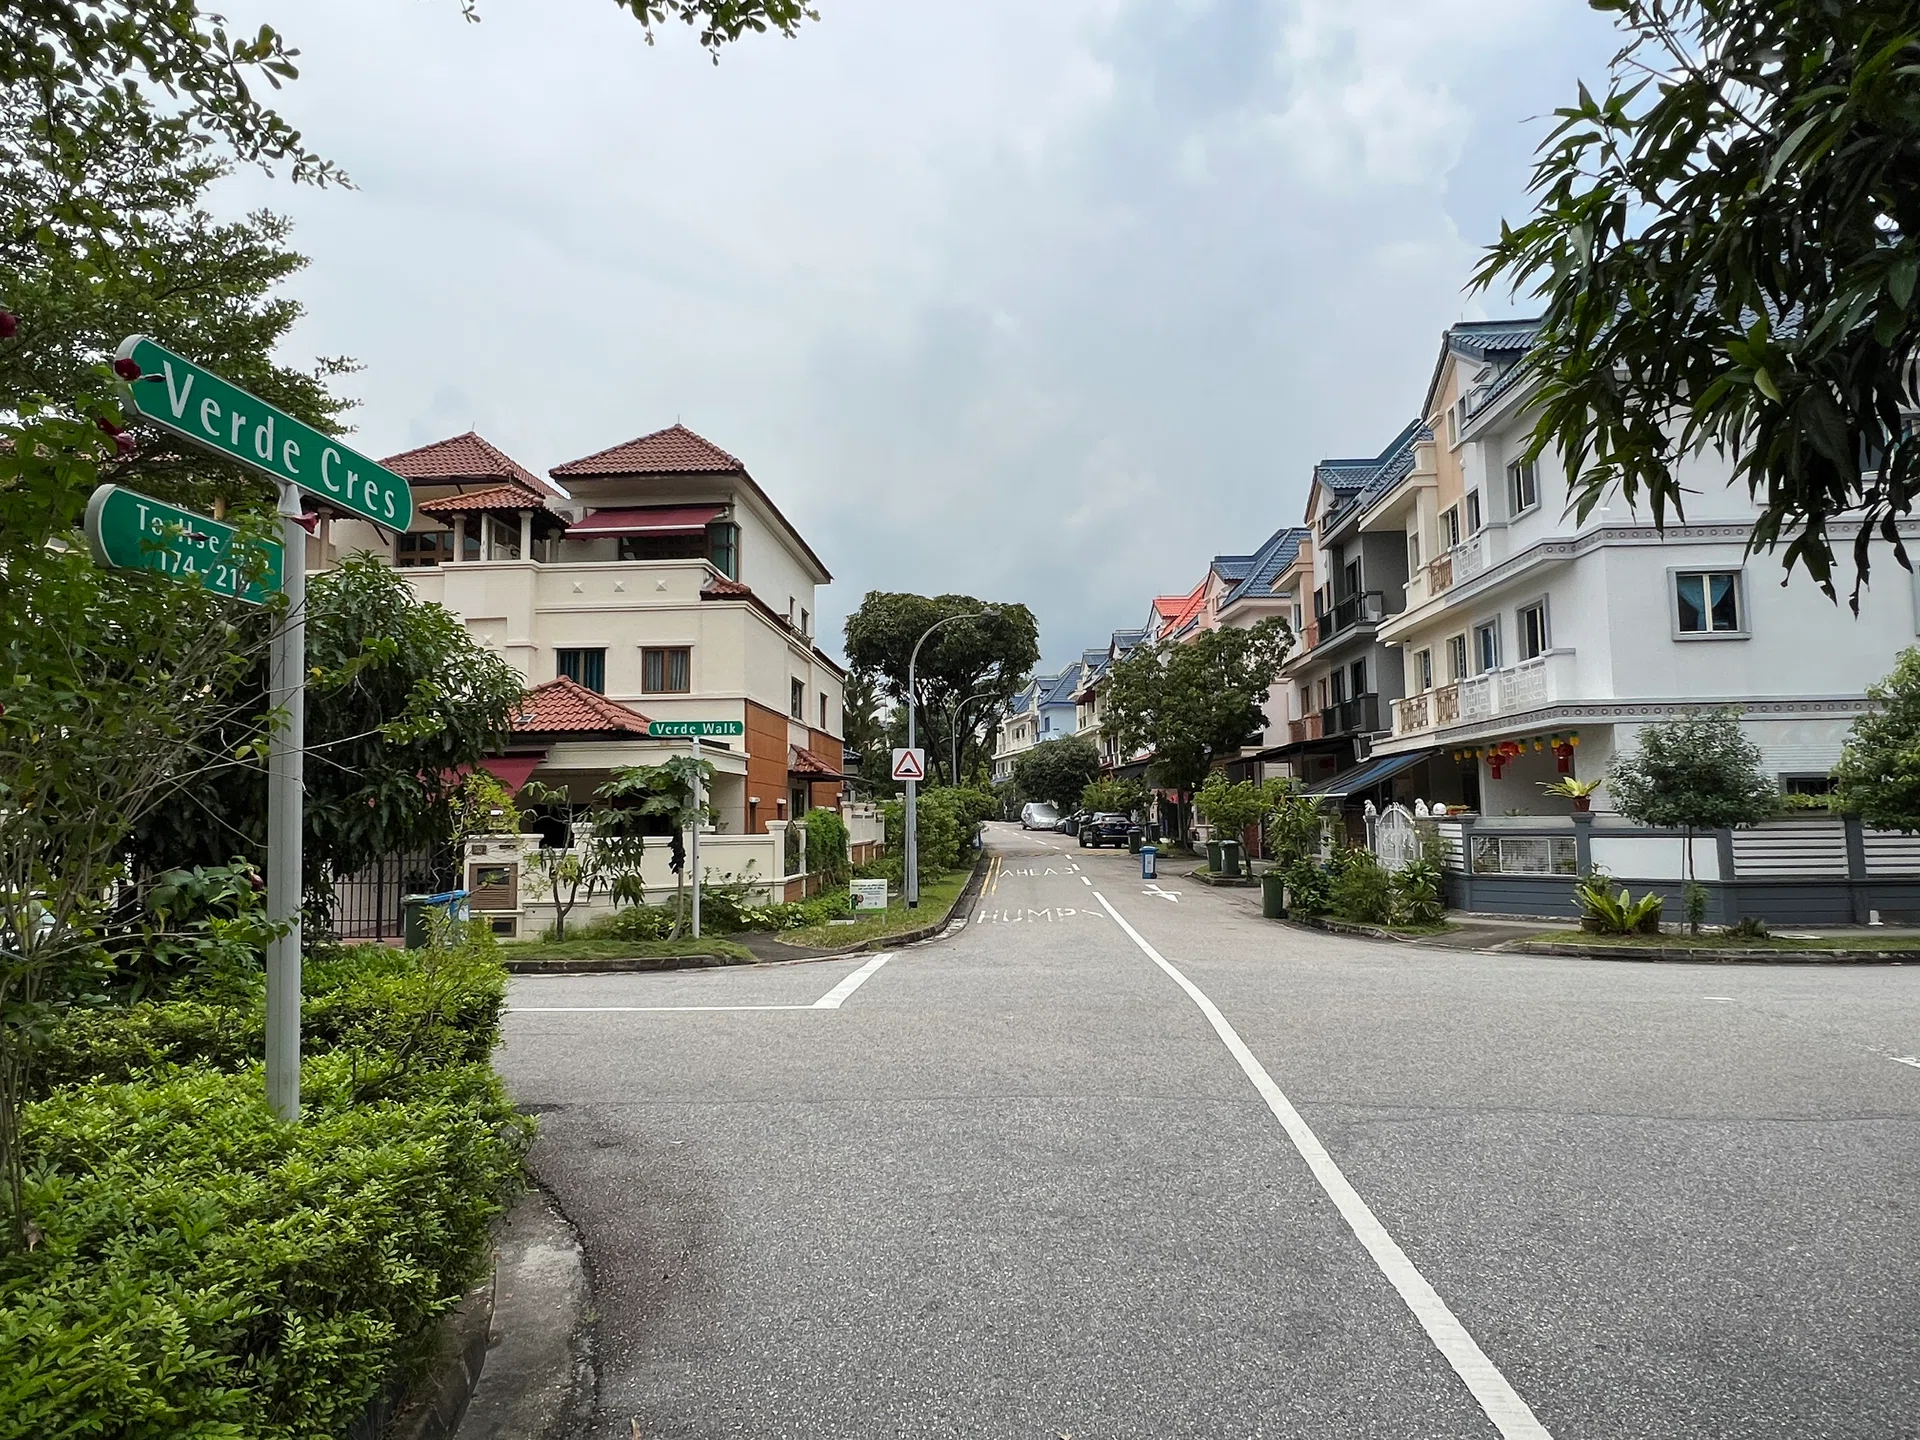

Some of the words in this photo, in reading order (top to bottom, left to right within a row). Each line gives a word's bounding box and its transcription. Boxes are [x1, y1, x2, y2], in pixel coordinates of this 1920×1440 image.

[163, 360, 301, 475] Verde
[321, 447, 396, 519] Cres
[136, 503, 163, 536] To
[161, 549, 196, 577] 174
[655, 723, 697, 735] Verde
[702, 722, 737, 734] Walk
